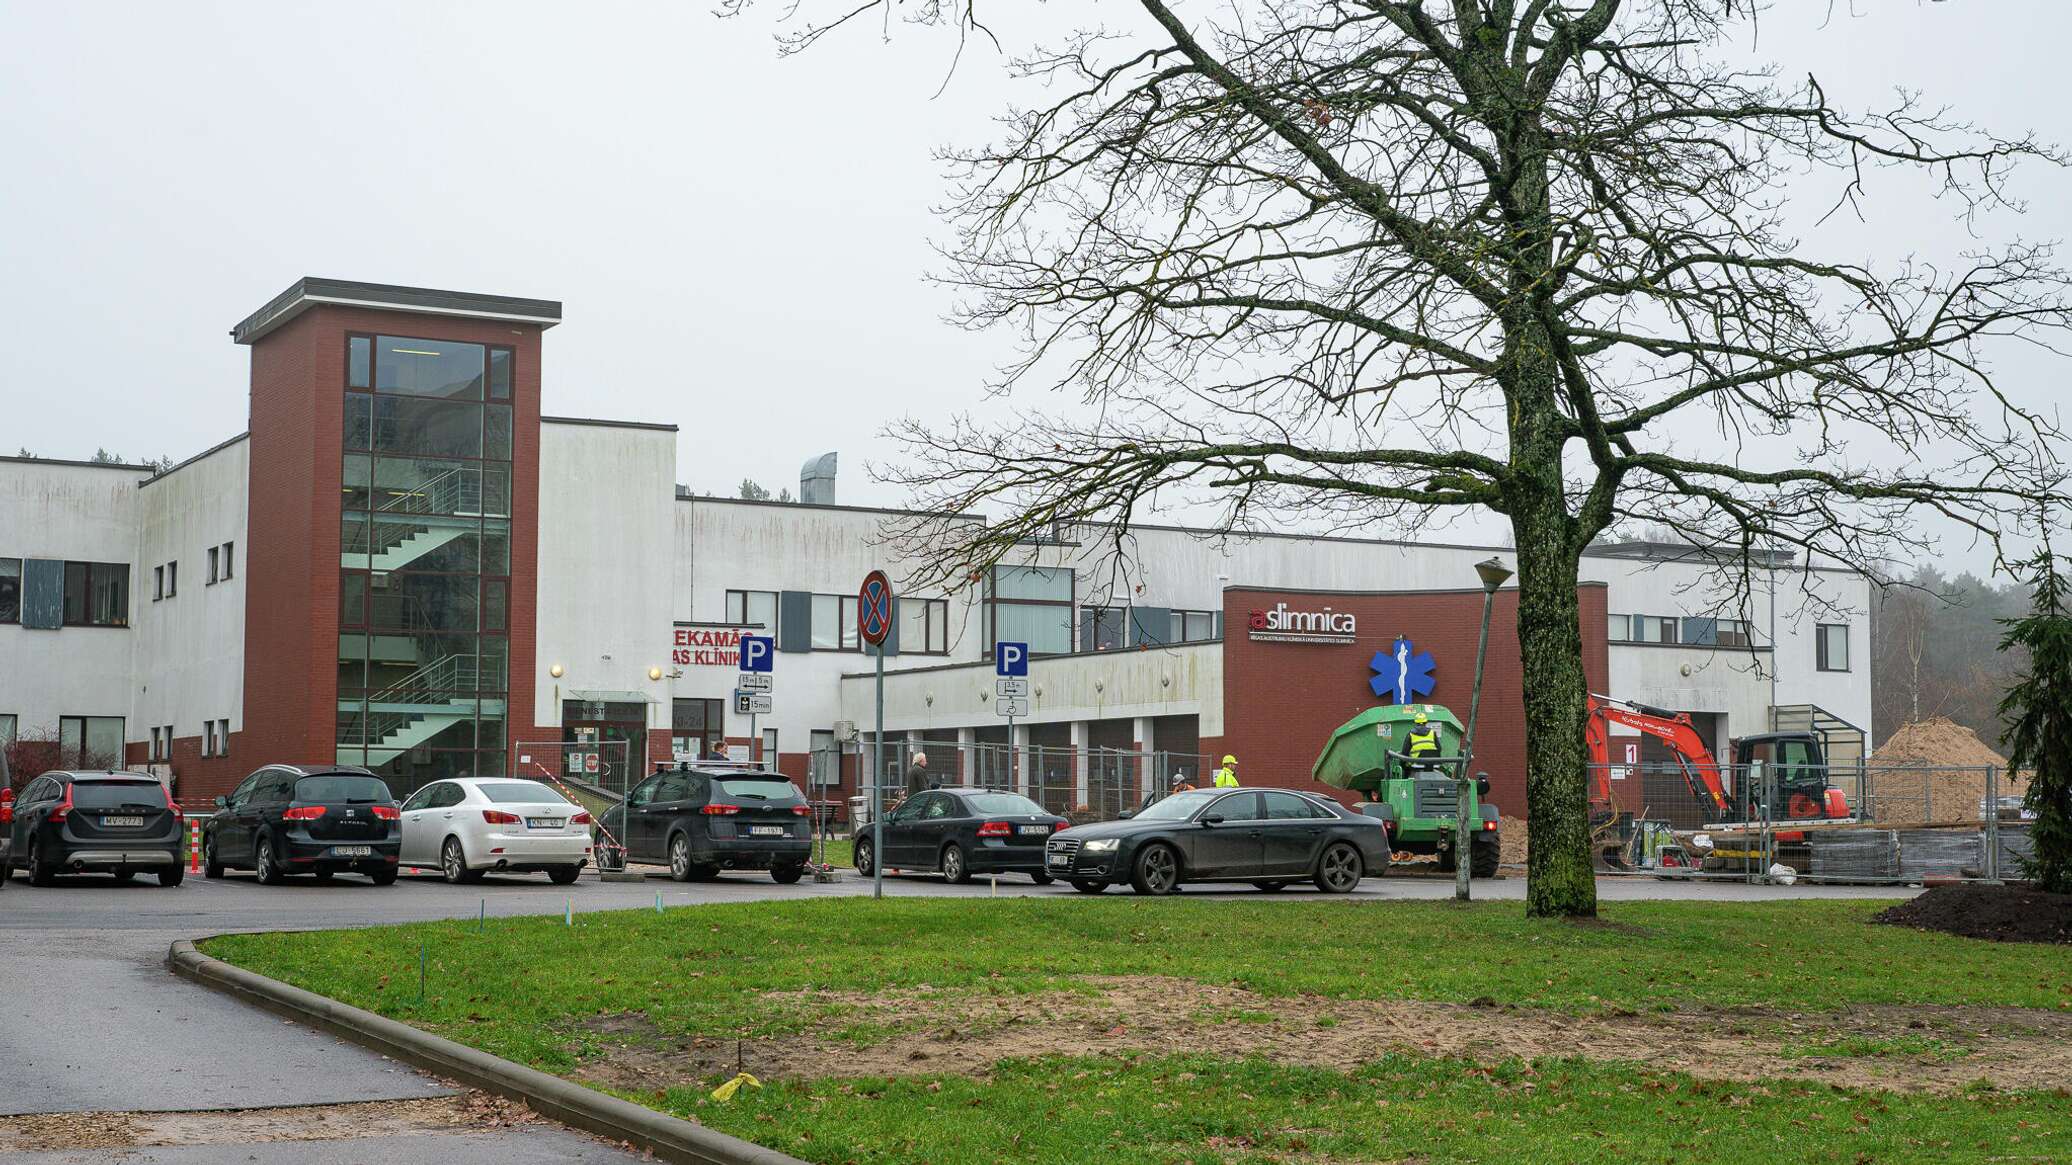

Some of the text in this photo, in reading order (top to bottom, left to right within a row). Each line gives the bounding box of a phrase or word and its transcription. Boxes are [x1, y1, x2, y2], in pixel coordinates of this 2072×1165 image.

[674, 629, 753, 647] EKAMĀ
[748, 640, 766, 668] P
[1004, 646, 1021, 672] P
[1628, 745, 1635, 763] 1
